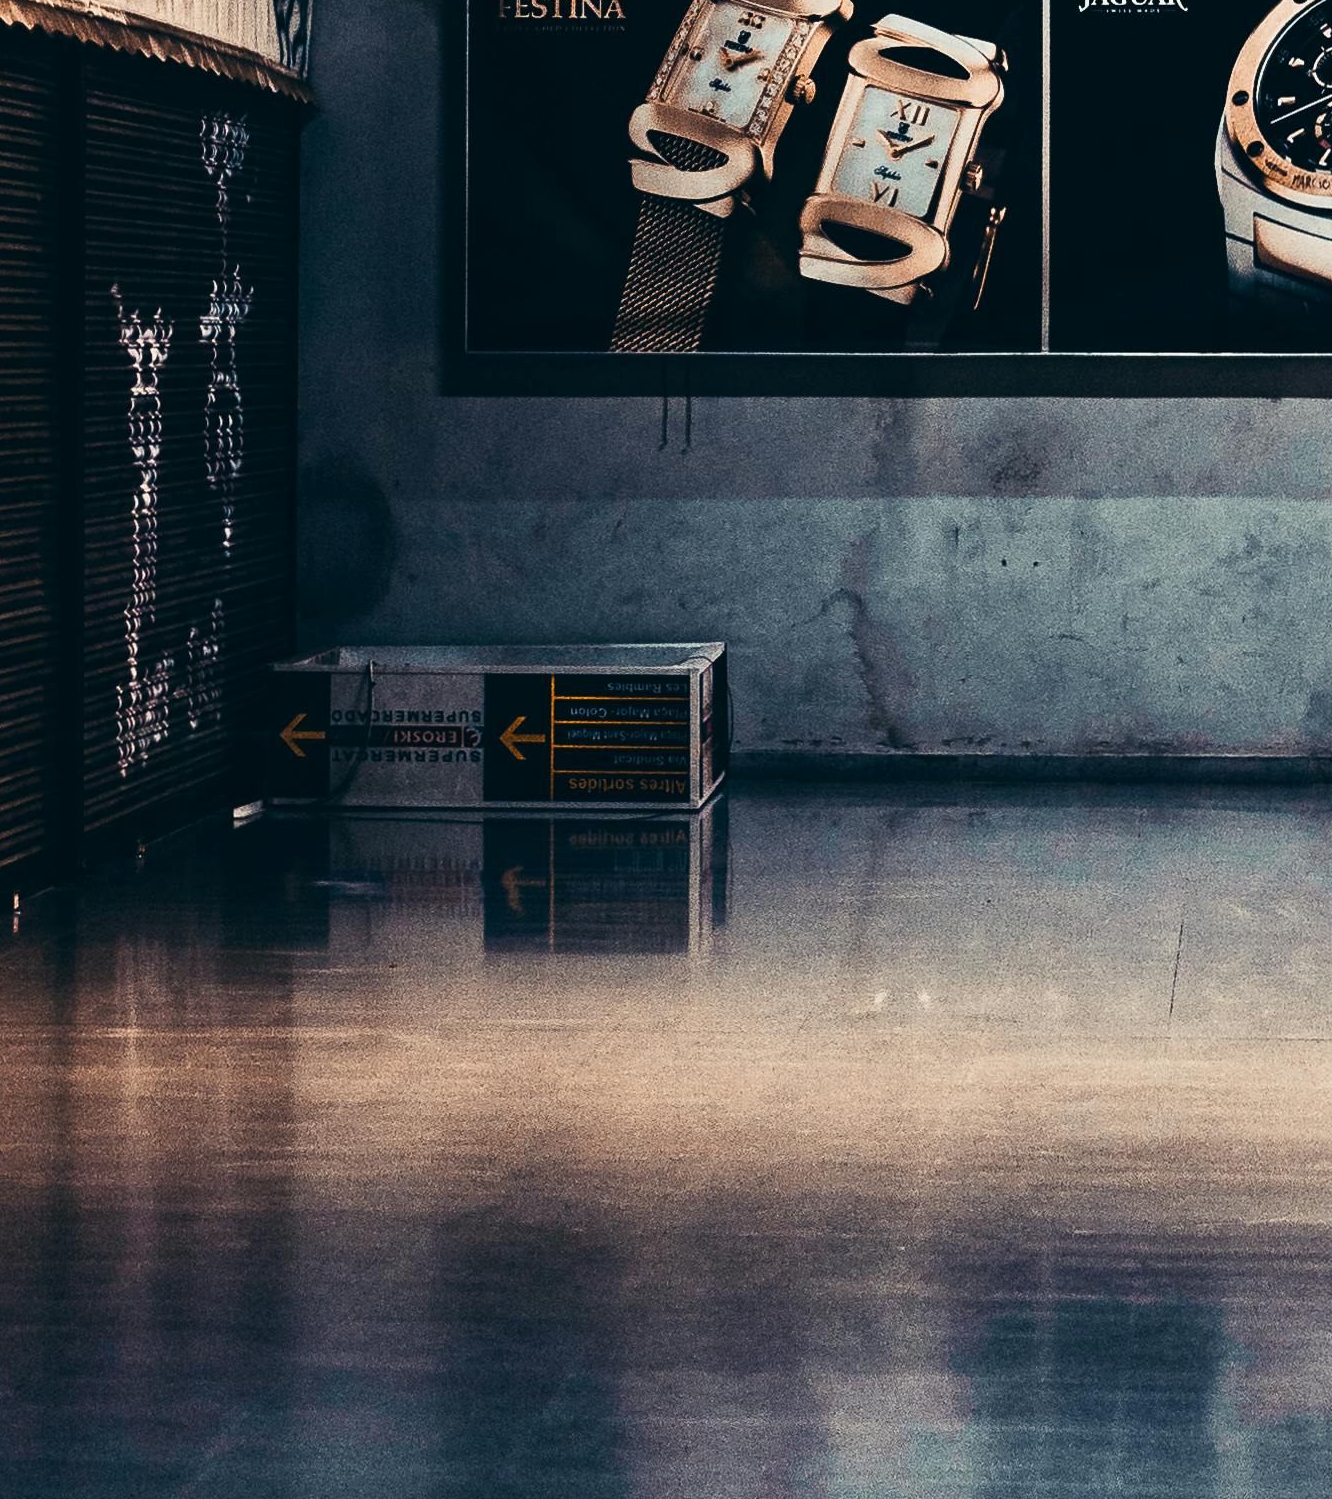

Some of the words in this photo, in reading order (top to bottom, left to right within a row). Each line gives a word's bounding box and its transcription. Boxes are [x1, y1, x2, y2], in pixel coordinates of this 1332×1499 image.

[332, 709, 481, 723] SUPERMERCADO
[393, 730, 457, 742] EROSKI
[332, 750, 481, 762] SUPERMERCAT
[569, 778, 635, 794] sortides
[640, 778, 686, 794] Altres
